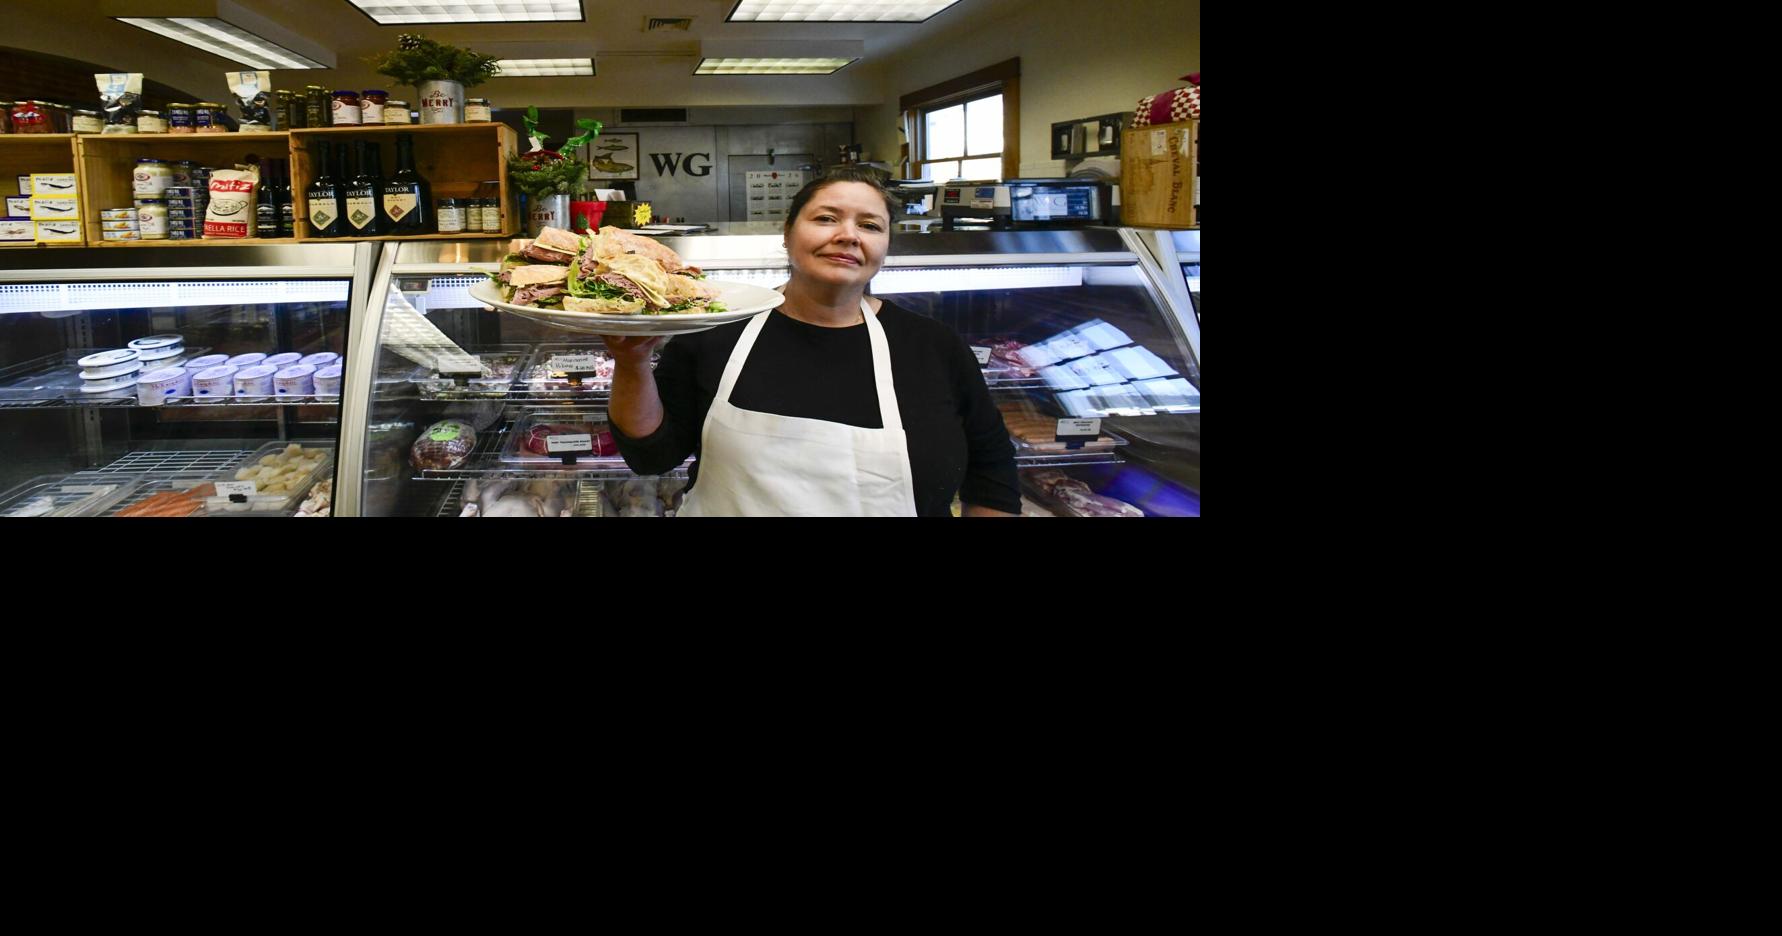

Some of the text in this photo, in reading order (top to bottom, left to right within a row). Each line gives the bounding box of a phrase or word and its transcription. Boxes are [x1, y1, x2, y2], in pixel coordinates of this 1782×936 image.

[421, 97, 454, 108] MERRY
[649, 153, 712, 177] WG
[309, 190, 334, 198] TAYLOR
[1167, 181, 1183, 213] BLANC
[227, 225, 246, 233] RICE
